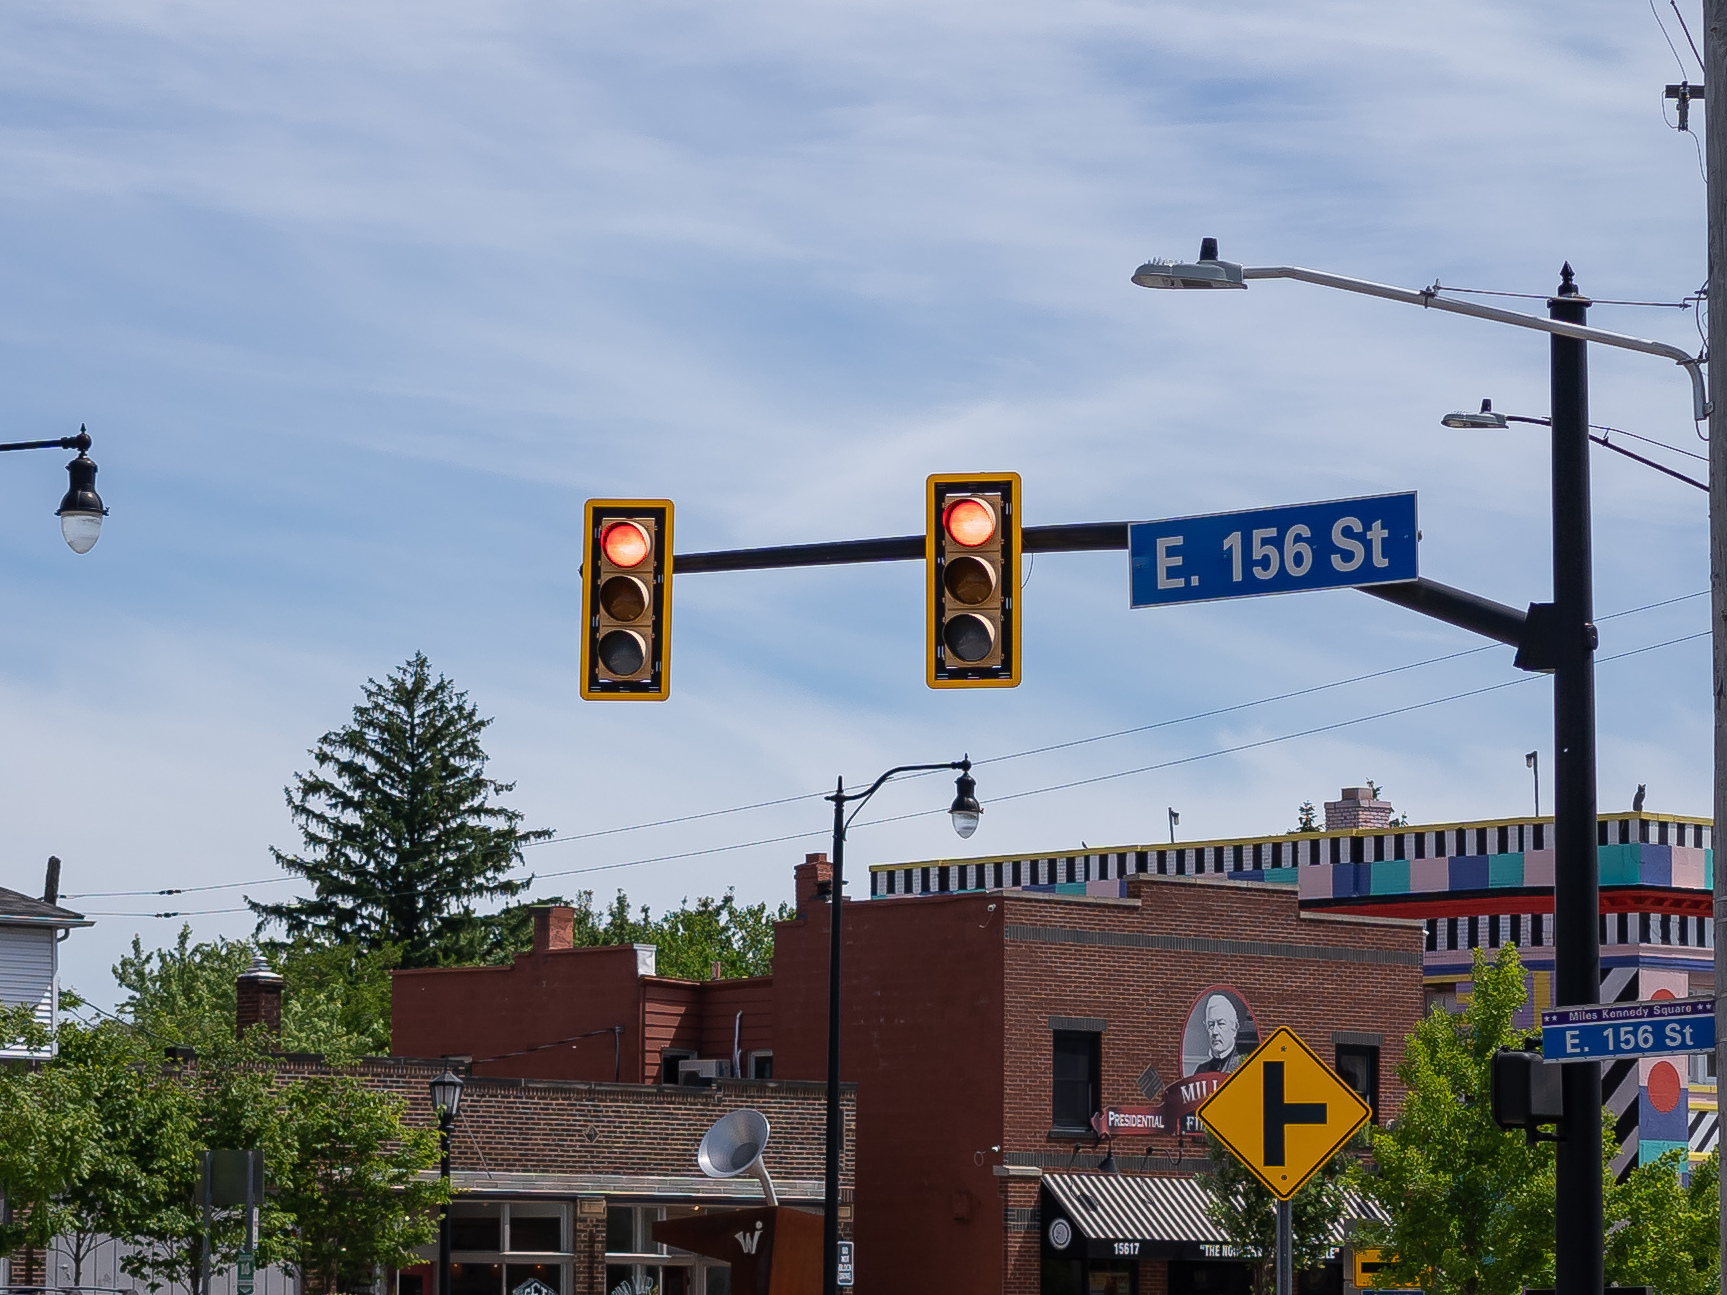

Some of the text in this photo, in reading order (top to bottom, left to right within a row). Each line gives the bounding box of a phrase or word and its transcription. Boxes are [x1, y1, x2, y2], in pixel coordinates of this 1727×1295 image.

[1156, 516, 1389, 590] E. 156 St
[1569, 1004, 1692, 1021] Miles Kennedy Square
[1565, 1022, 1694, 1054] E. 156 St
[1114, 1242, 1140, 1255] 15617
